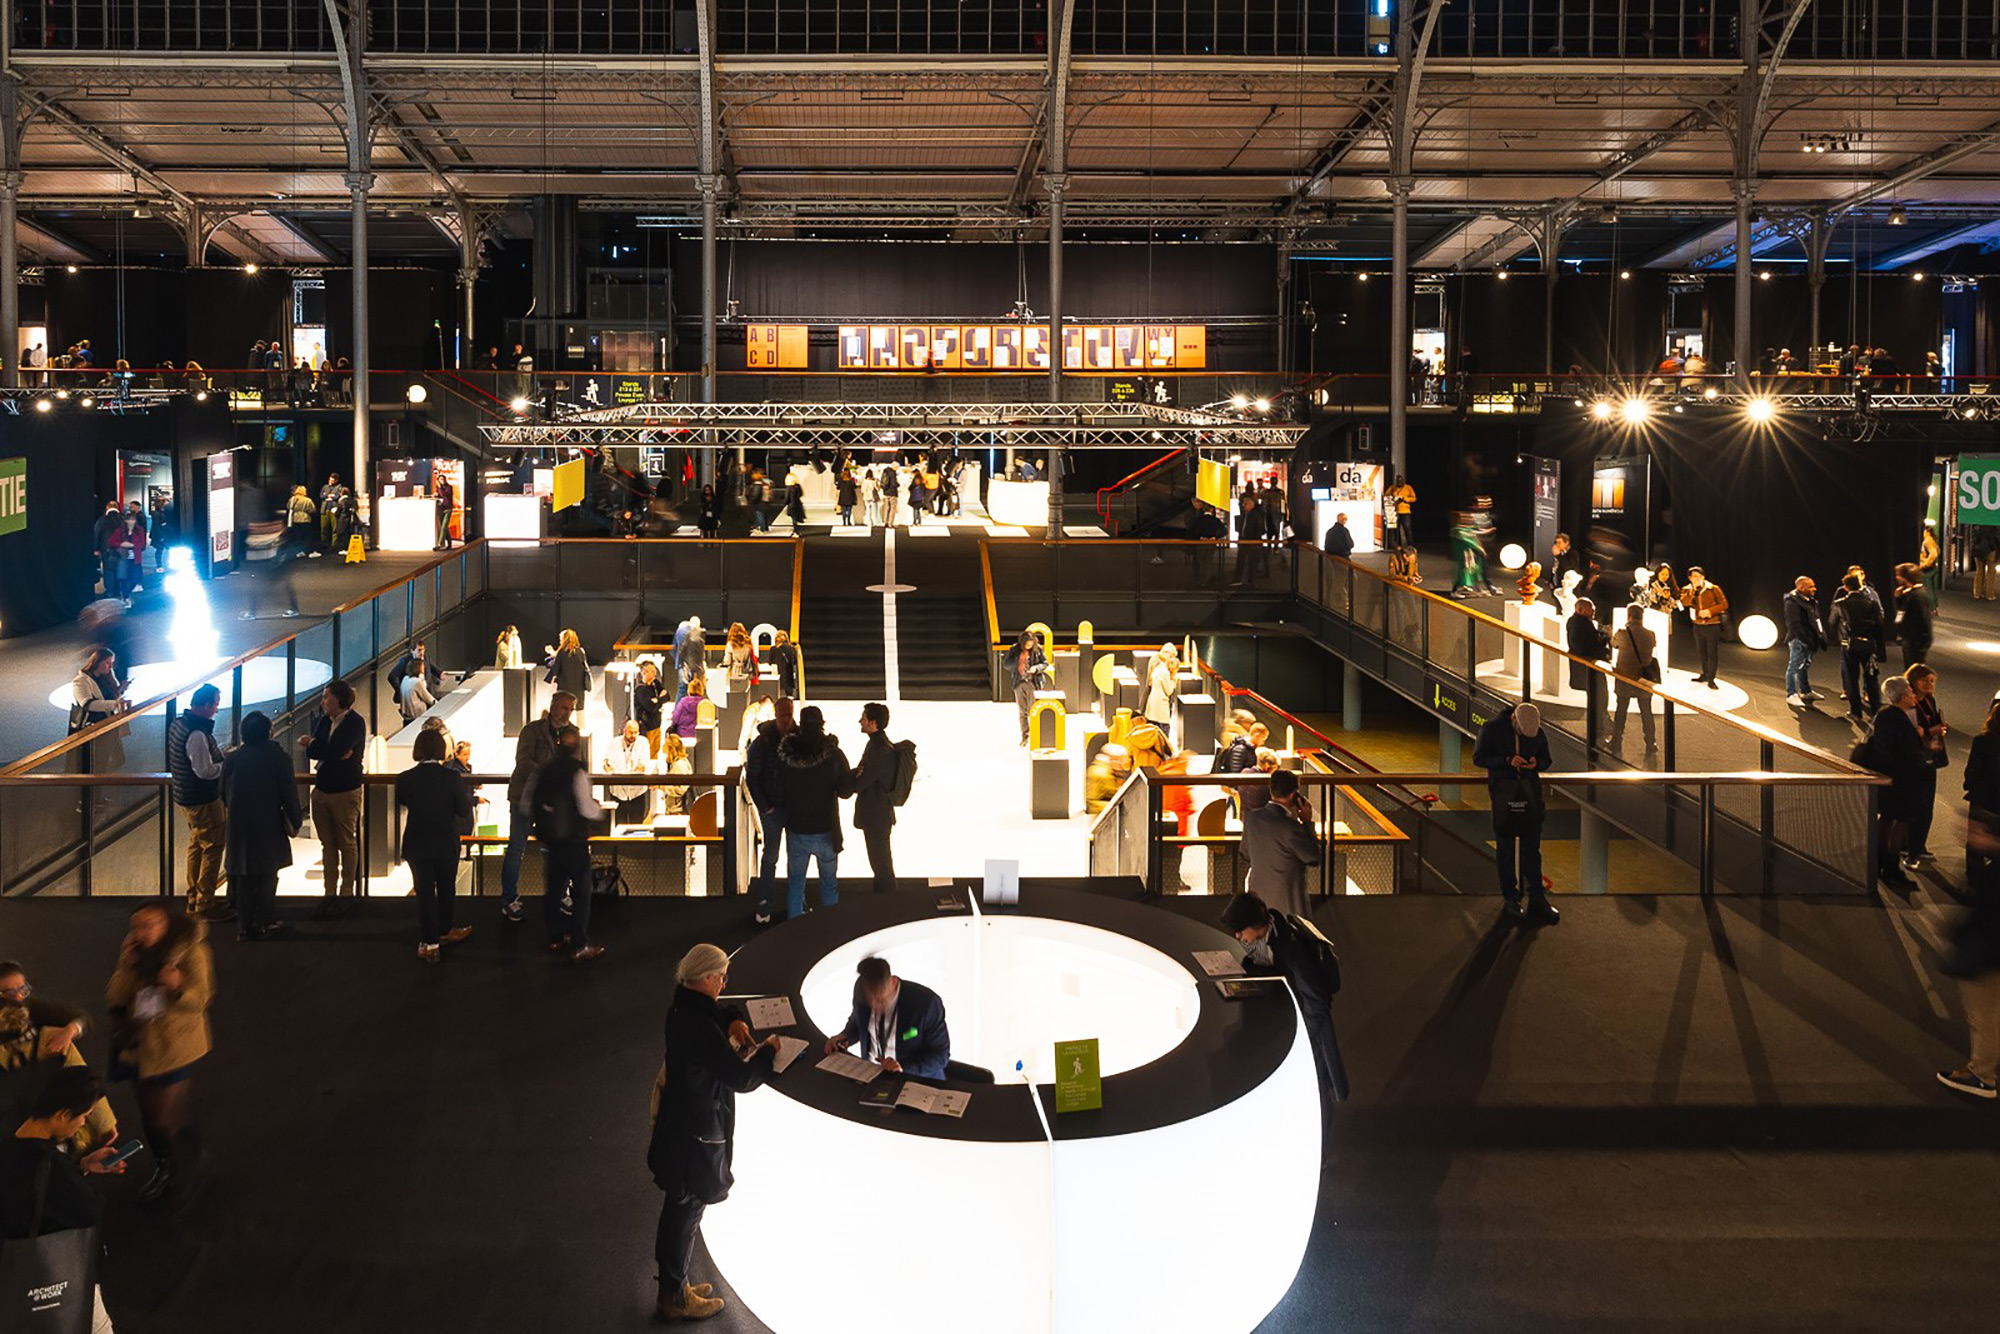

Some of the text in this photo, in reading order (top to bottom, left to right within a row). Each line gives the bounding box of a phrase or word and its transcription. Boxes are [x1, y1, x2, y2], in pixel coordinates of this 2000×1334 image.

[750, 327, 774, 342] A B
[750, 350, 774, 365] C D
[27, 1281, 68, 1297] ARCHITECT
